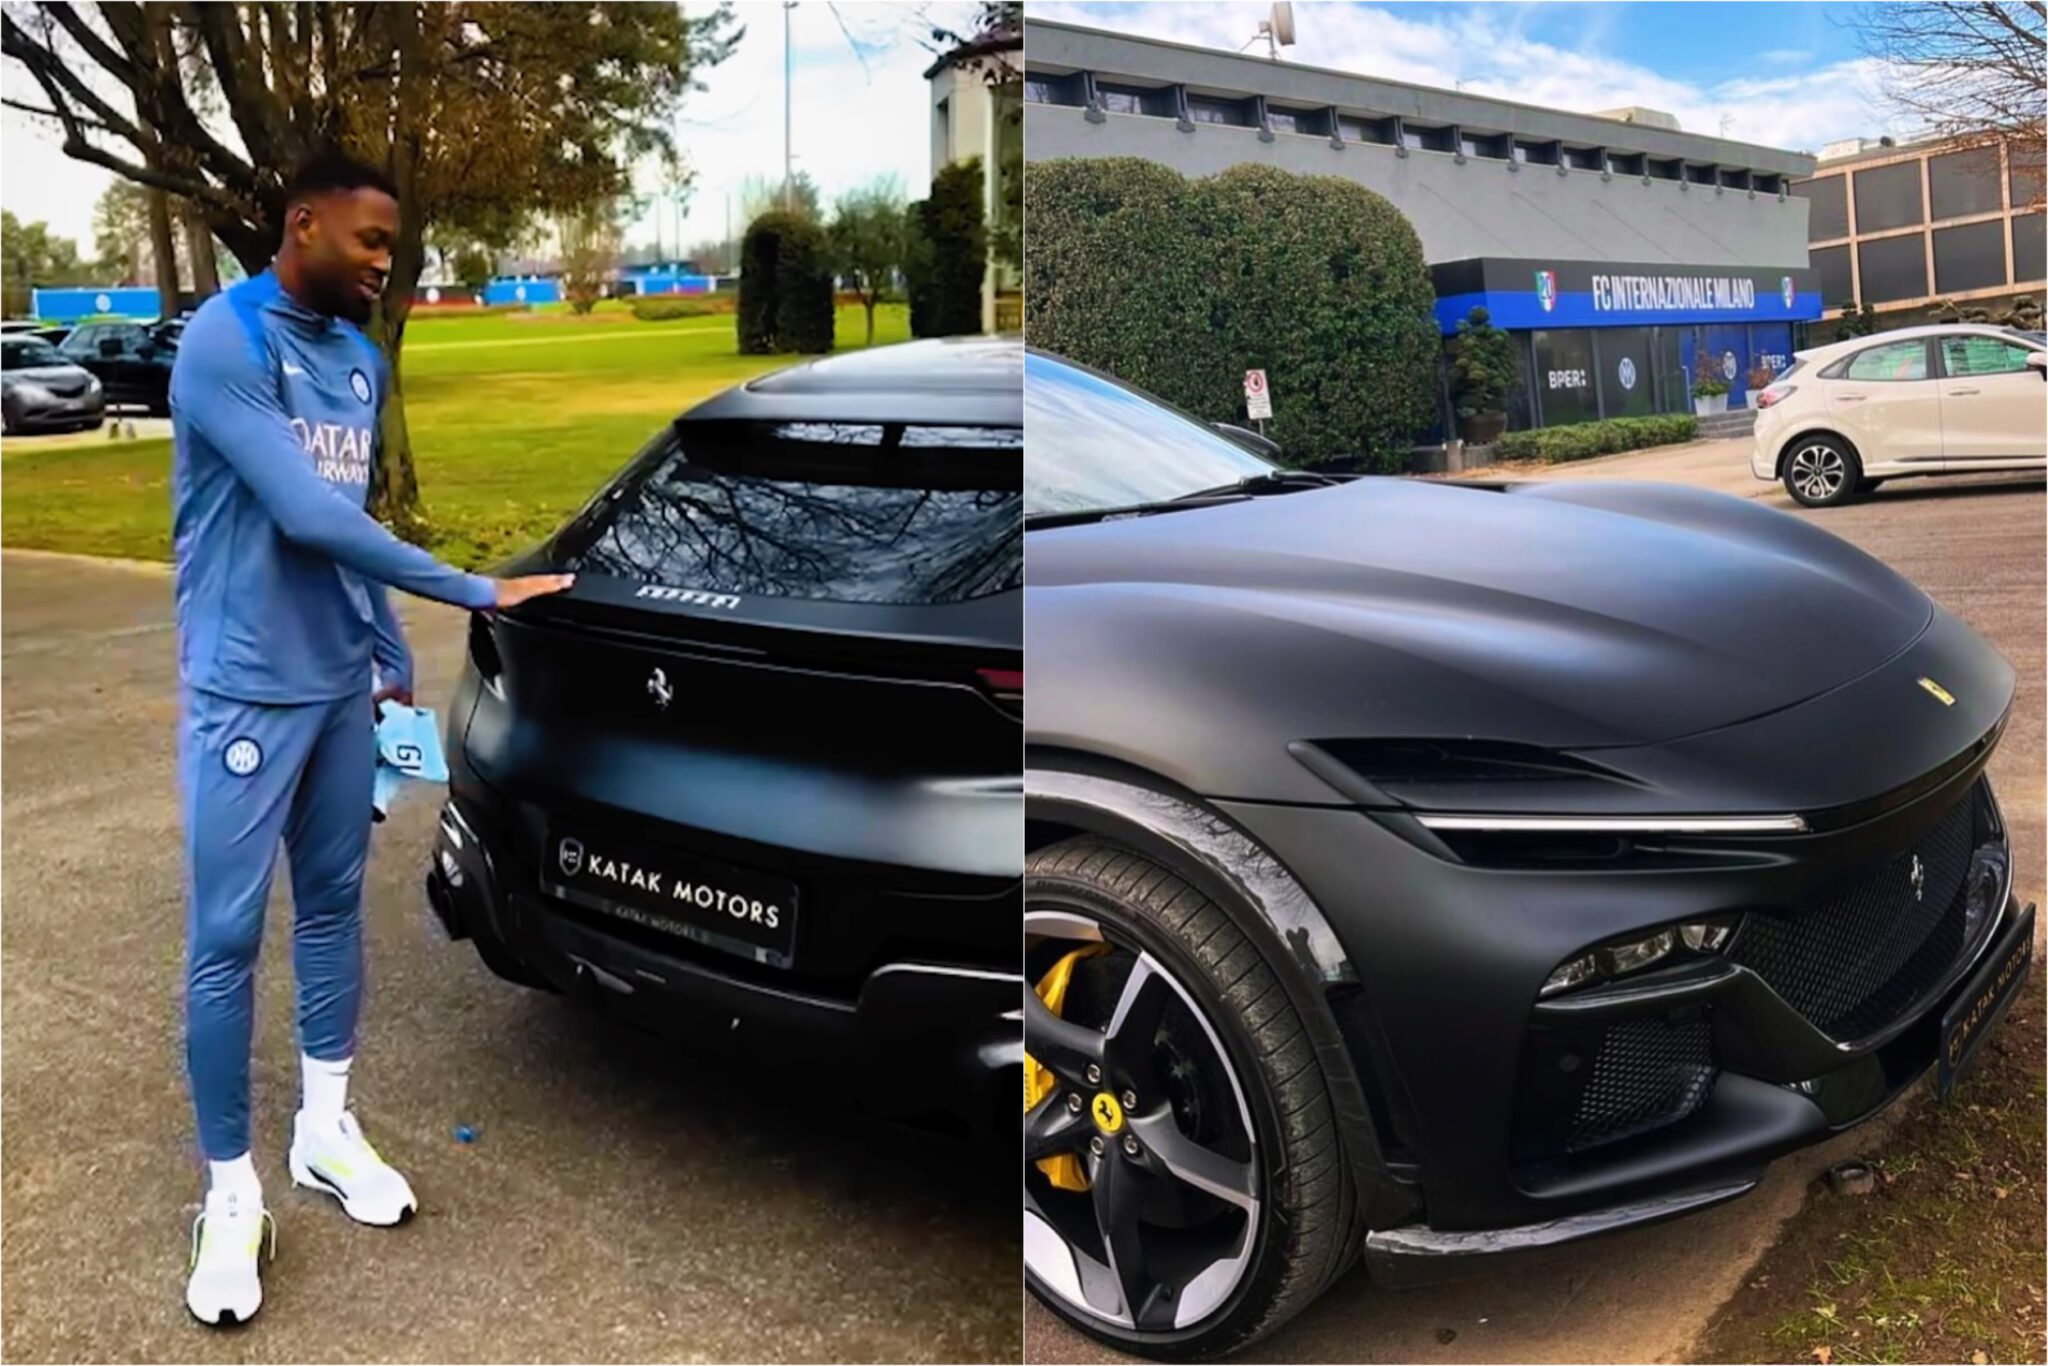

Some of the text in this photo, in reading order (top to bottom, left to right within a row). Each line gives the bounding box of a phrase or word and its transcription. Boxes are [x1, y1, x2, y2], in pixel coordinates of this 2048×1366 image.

[1592, 275, 1612, 311] FC
[1611, 275, 1714, 310] INTERNAZIONALE
[1713, 277, 1755, 309] MILANO
[317, 460, 370, 485] IRWAYS
[588, 854, 780, 929] KATAK MOTORS
